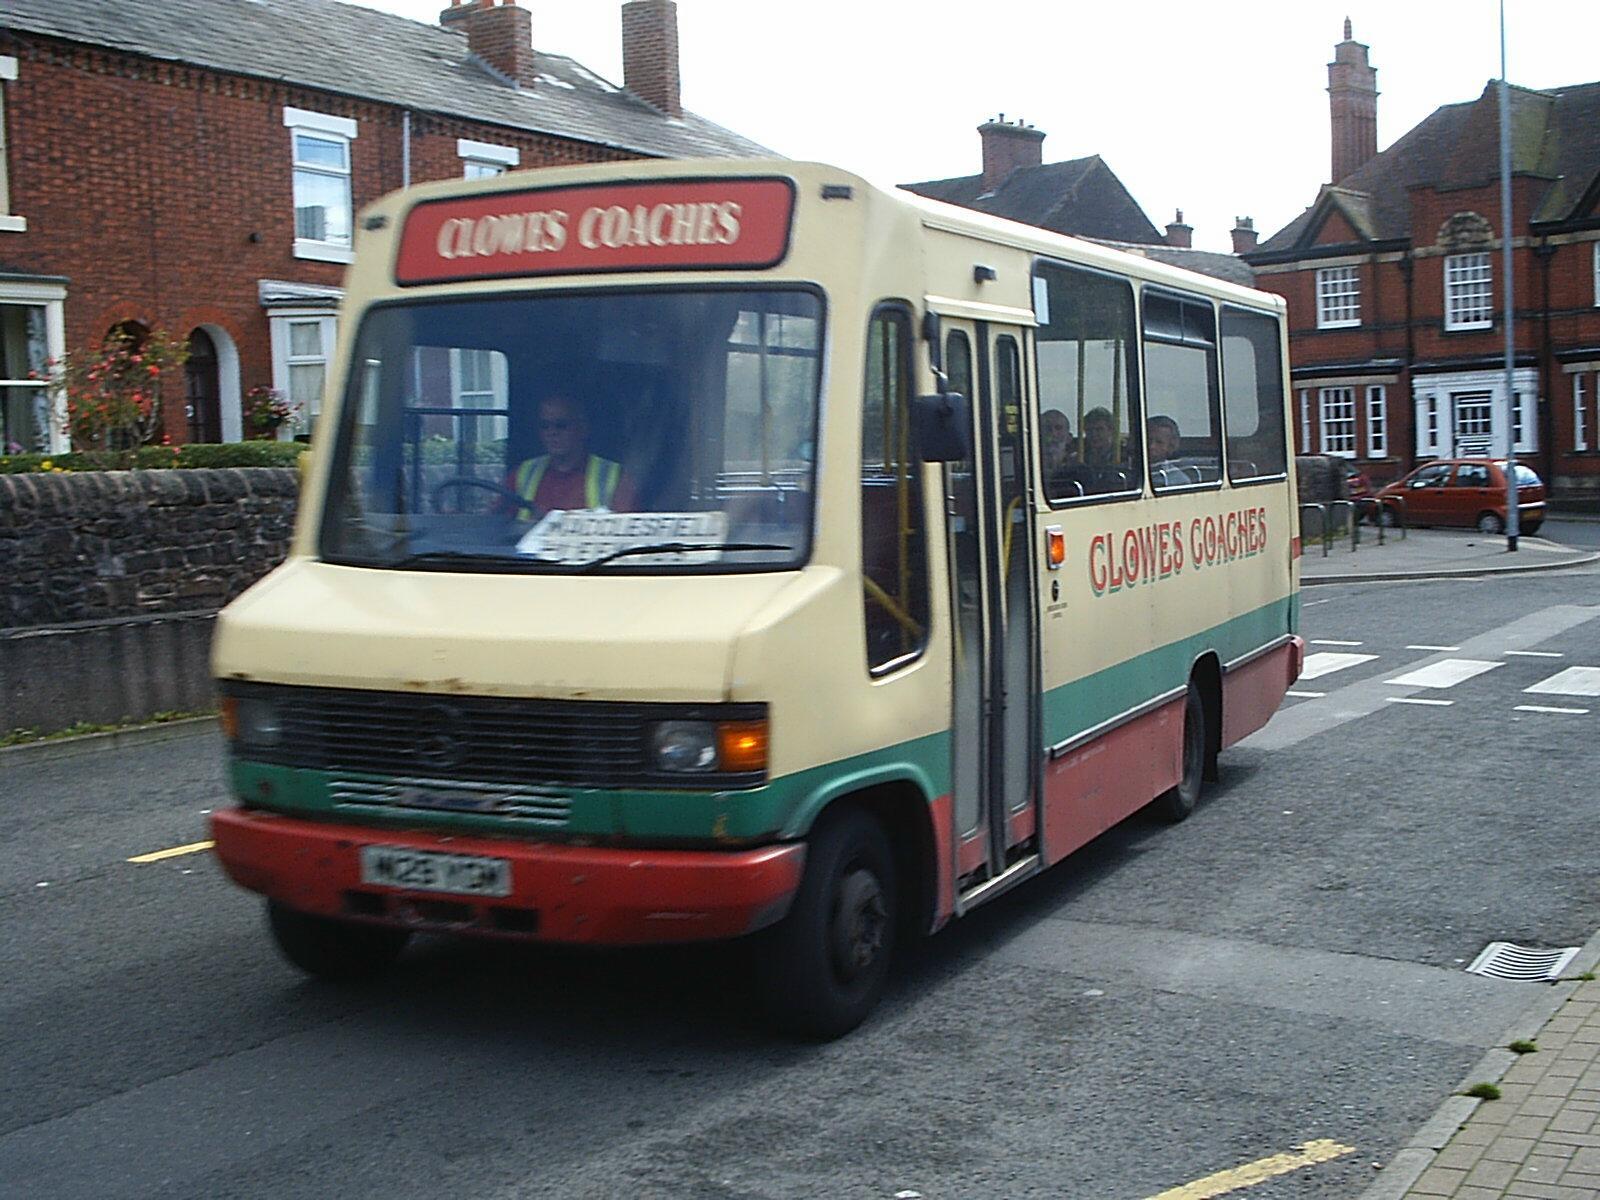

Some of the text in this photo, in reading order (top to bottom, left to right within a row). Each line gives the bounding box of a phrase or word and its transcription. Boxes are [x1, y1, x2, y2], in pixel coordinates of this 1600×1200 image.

[437, 201, 741, 259] CLOWES COACHES
[1089, 507, 1267, 598] CLOWES COACHES
